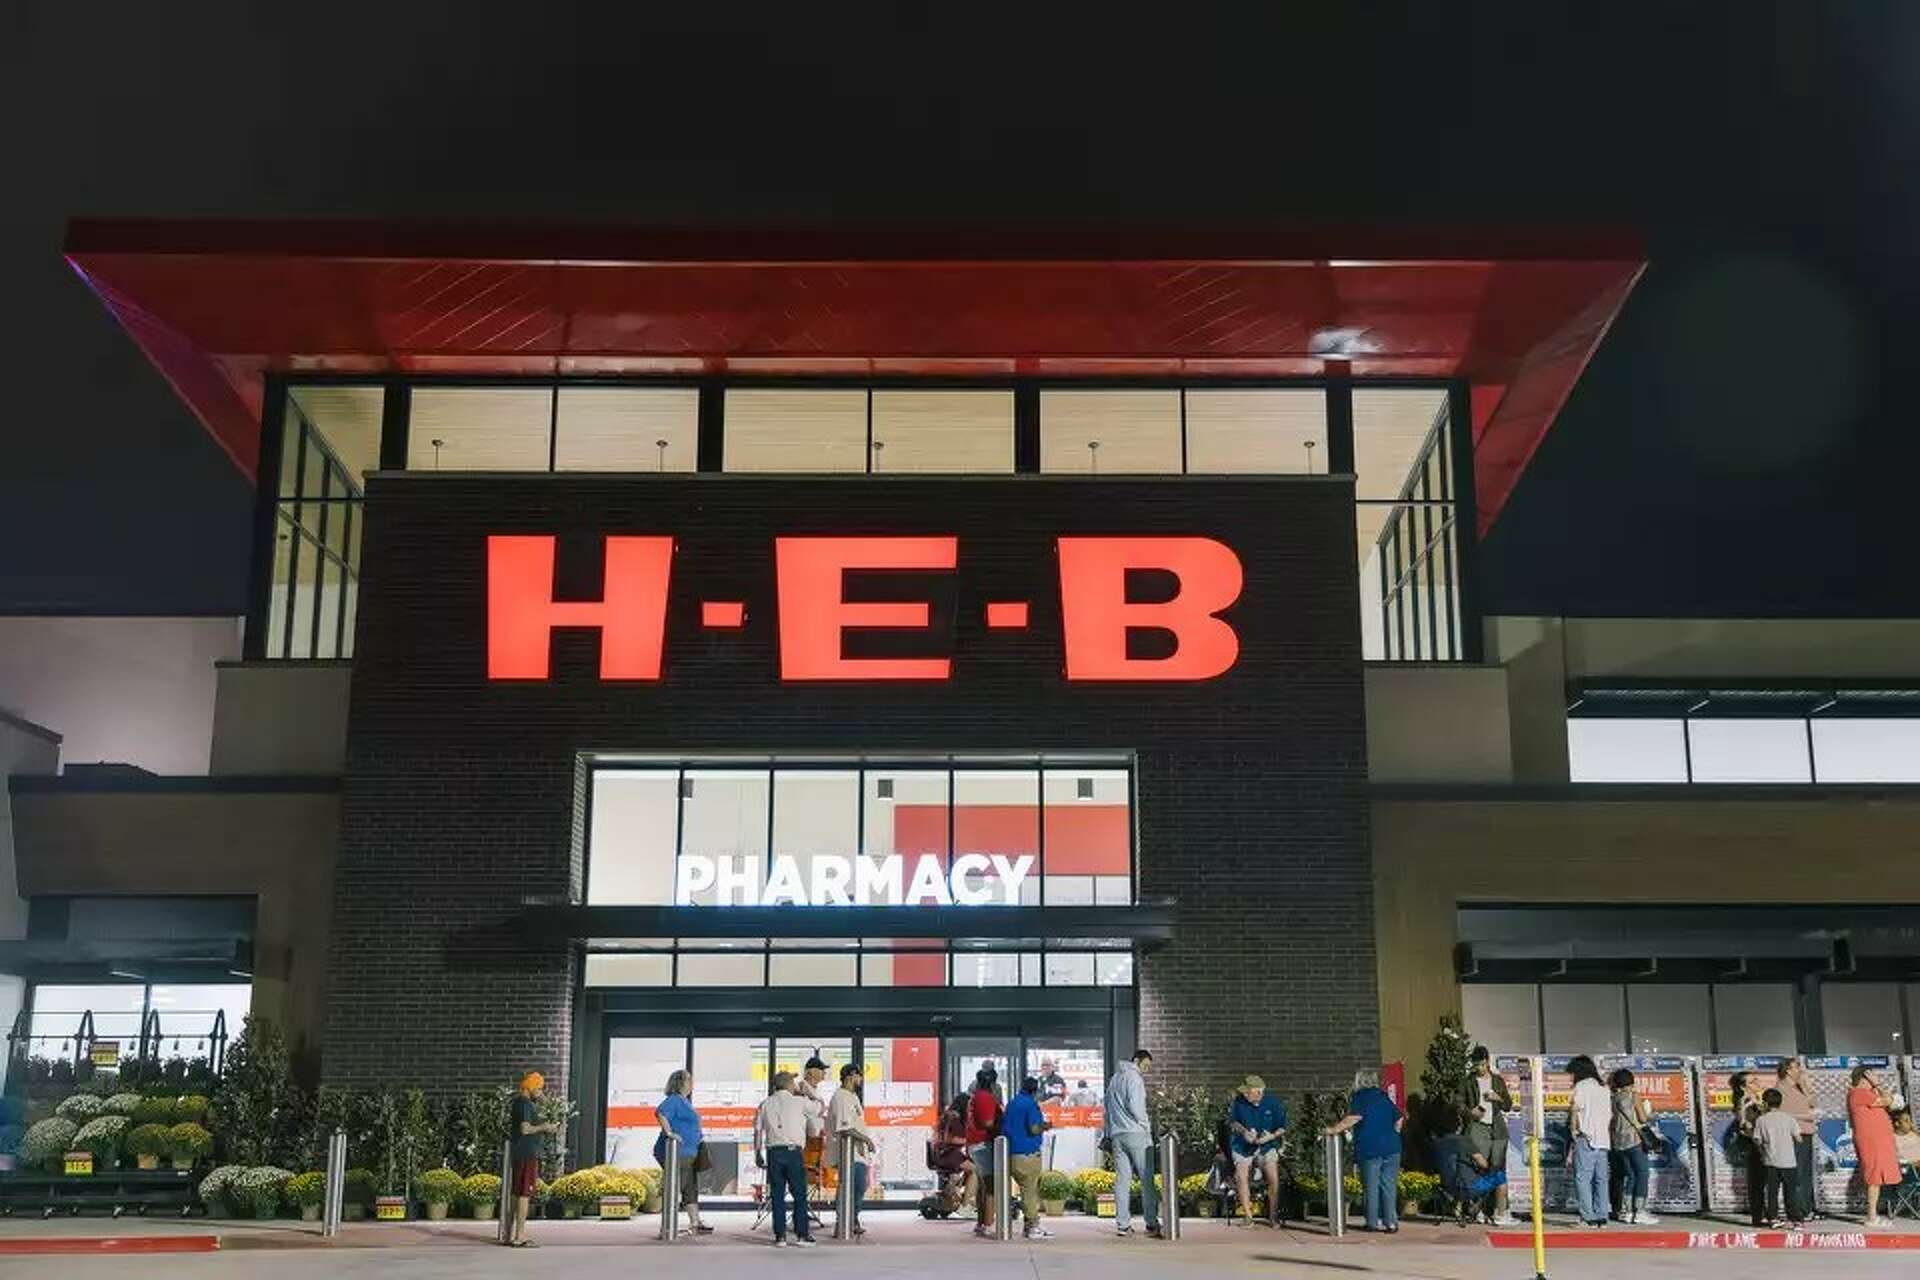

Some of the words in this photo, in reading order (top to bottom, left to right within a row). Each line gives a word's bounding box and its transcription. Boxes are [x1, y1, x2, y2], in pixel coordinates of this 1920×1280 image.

[676, 853, 1035, 906] PHARMACY
[1688, 1232, 1719, 1248] FIRE
[1725, 1232, 1759, 1248] LANE
[1784, 1232, 1804, 1248] NO
[1810, 1232, 1866, 1248] PARKING
